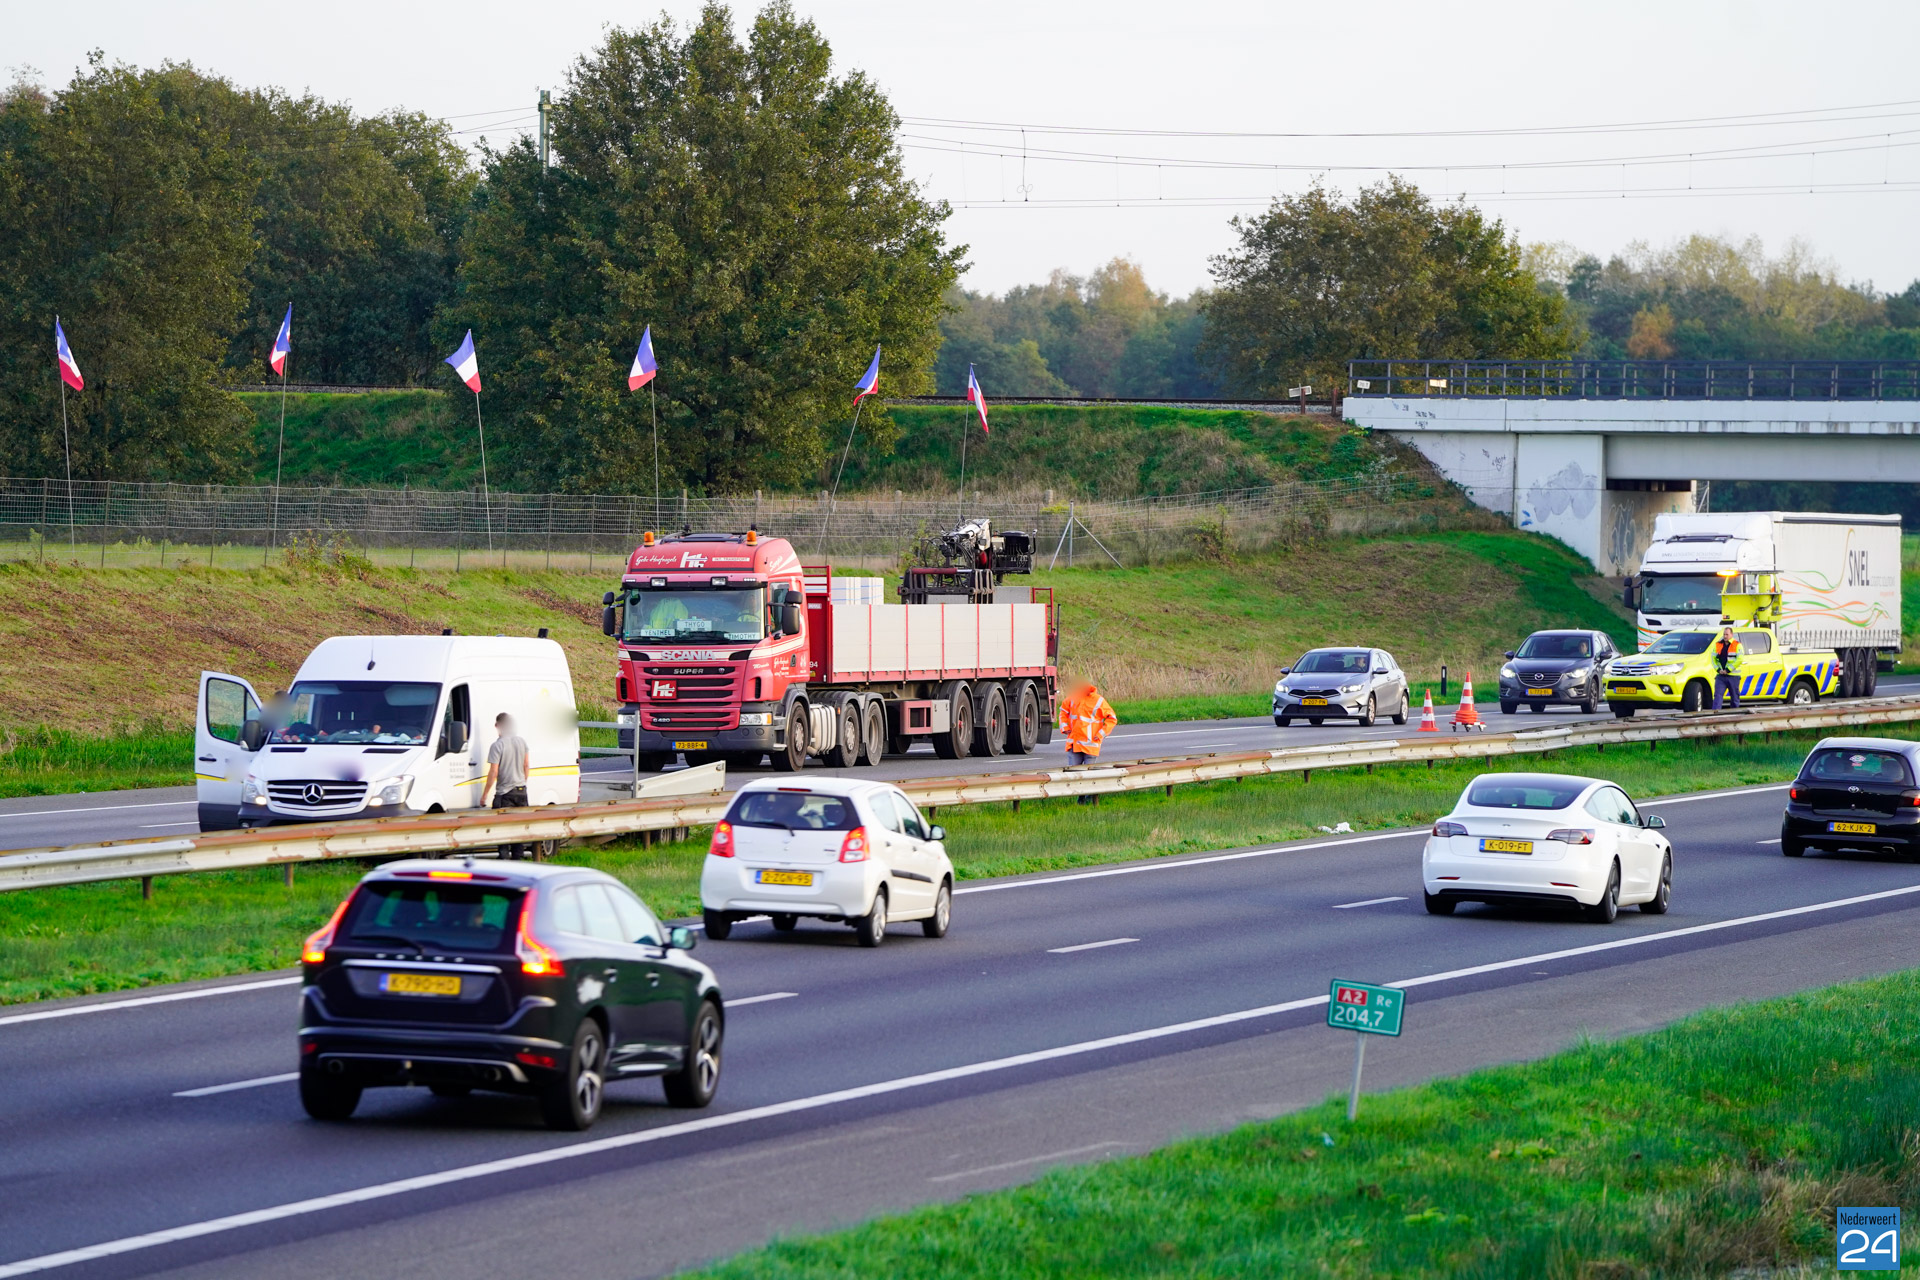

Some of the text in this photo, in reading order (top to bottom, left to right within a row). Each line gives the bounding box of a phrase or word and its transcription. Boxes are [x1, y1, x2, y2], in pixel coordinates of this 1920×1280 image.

[1848, 550, 1870, 587] SNEL
[1670, 618, 1710, 626] SCANIA
[660, 650, 716, 660] SCANIA
[1836, 823, 1872, 833] 62-KJK-2
[1488, 841, 1528, 851] K-019-FT
[764, 872, 810, 884] 2-ZGN-95
[1342, 990, 1392, 1008] A2 Re
[1334, 1005, 1384, 1027] 204,7
